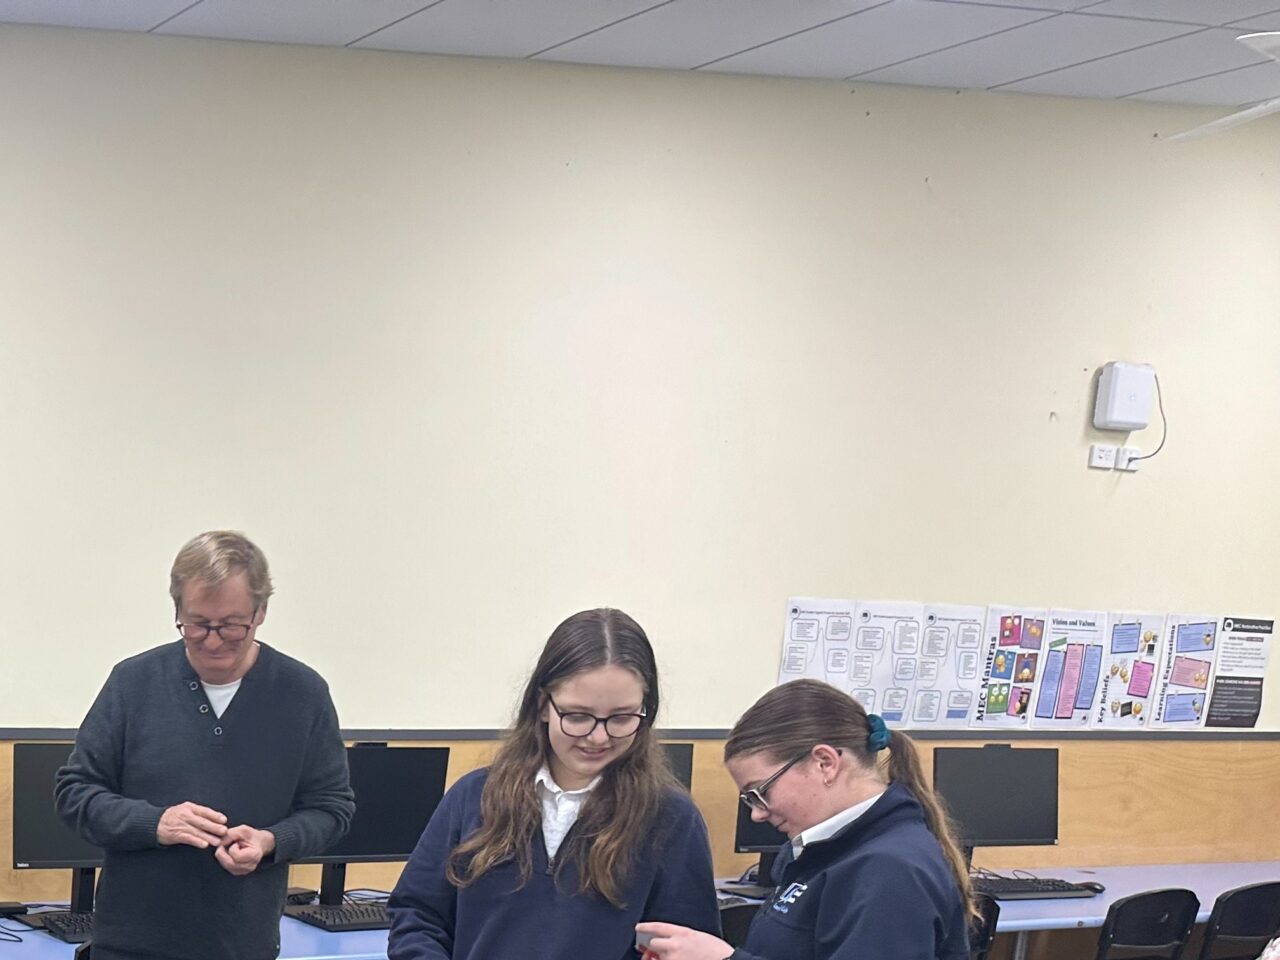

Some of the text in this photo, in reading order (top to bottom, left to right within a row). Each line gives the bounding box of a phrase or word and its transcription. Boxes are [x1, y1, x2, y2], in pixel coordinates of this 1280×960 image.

[1052, 618, 1067, 626] Vision
[1079, 619, 1096, 627] Values
[976, 636, 997, 722] MEC Mantras
[1097, 675, 1110, 723] Key Beliefs
[1155, 625, 1176, 721] Learning Expectations
